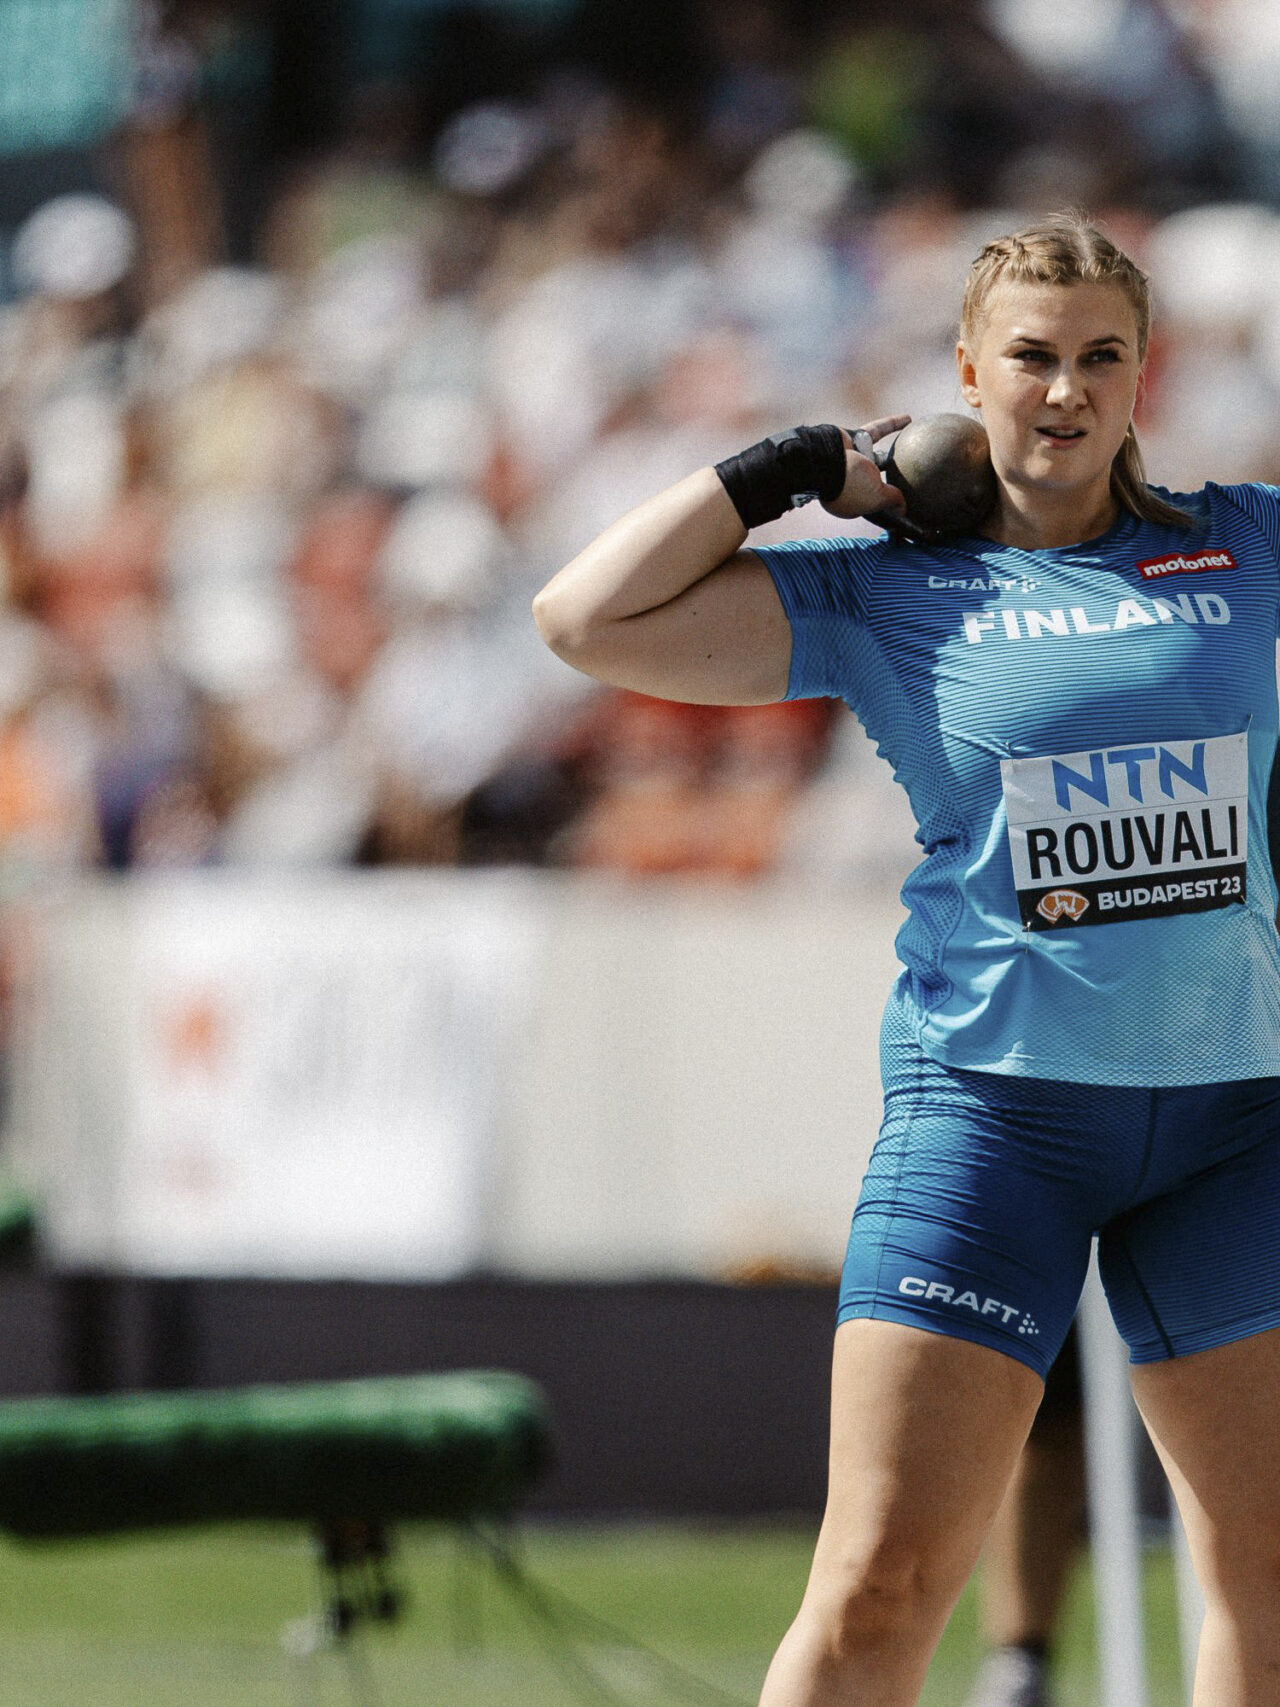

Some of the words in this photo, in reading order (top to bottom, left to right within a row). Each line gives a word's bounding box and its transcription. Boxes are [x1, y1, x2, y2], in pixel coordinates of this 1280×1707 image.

[1143, 553, 1232, 576] motonet
[962, 593, 1231, 644] FINLAND
[1051, 742, 1208, 812] NTN
[1026, 805, 1239, 880] ROUVALI
[898, 1276, 1019, 1324] CRAFT
